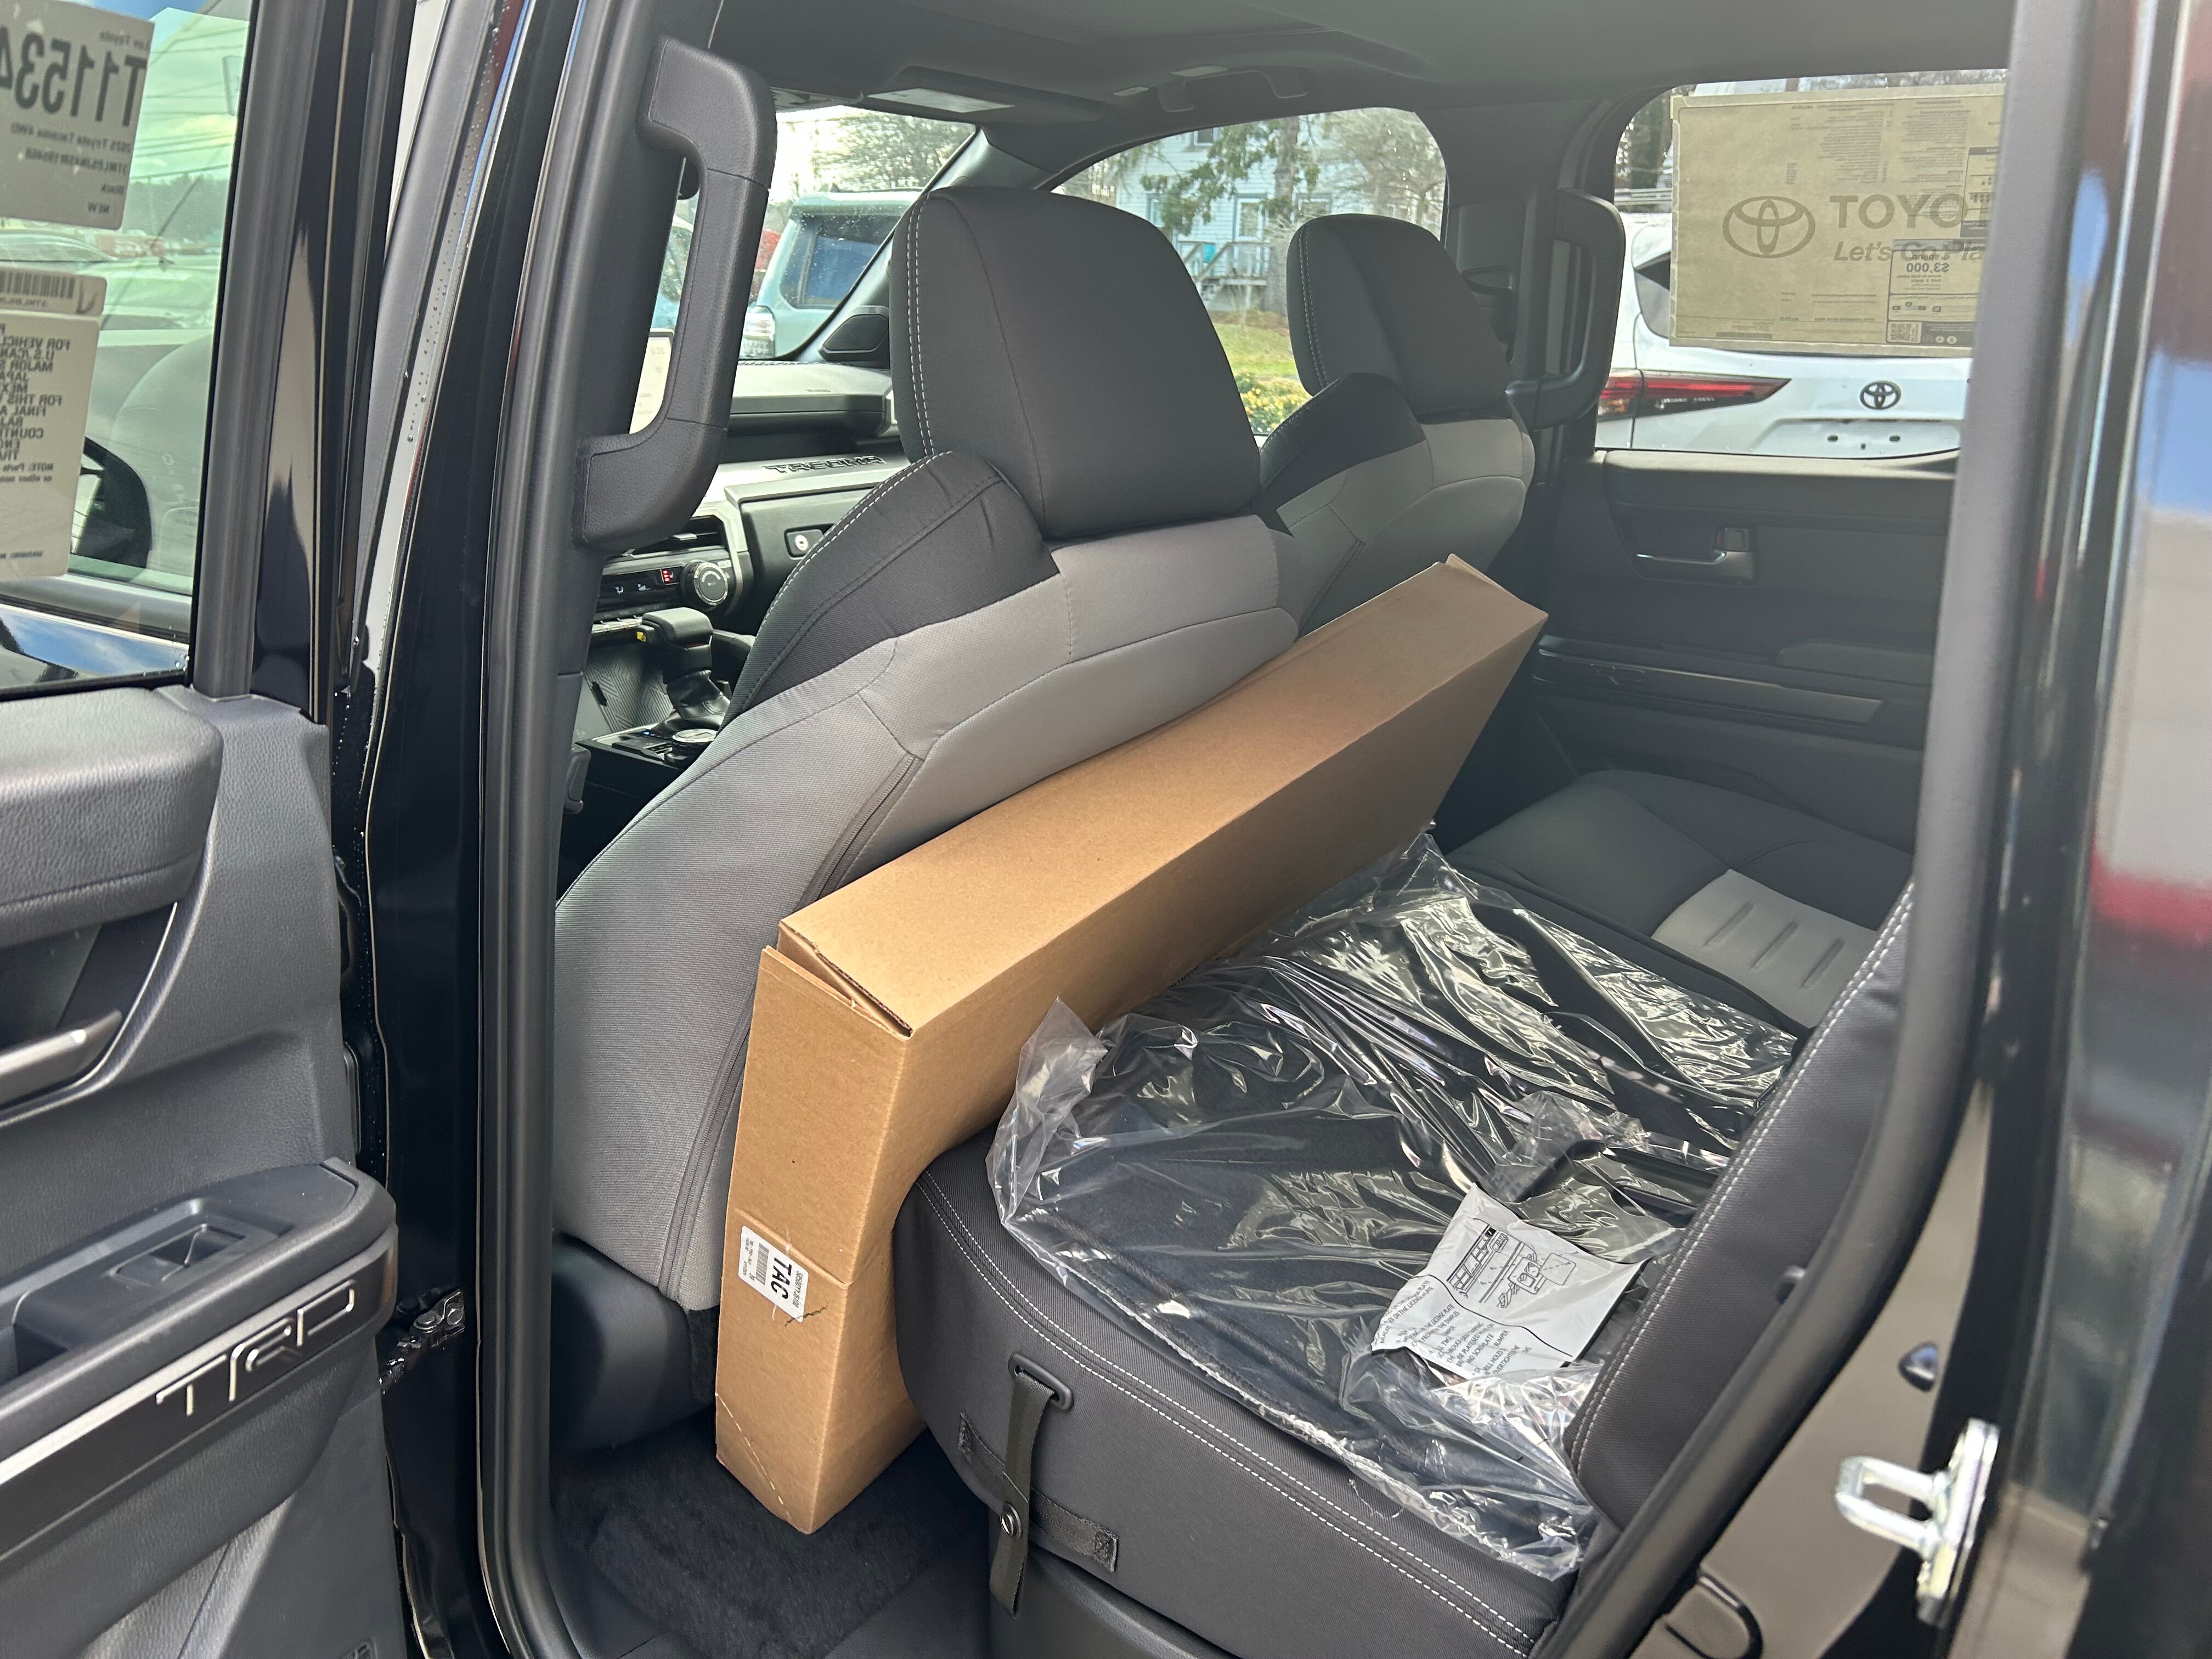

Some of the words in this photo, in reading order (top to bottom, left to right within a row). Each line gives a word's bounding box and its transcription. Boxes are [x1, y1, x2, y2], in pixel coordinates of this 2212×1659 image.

[1830, 193, 1991, 229] TOYOT
[1833, 240, 1893, 262] Let's
[762, 455, 888, 473] TACOMA
[770, 1256, 792, 1300] TAC
[1430, 1311, 1446, 1325] LICENSE
[1443, 1303, 1455, 1315] PLATE
[155, 1278, 357, 1418] TRD
[1489, 1349, 1504, 1364] HOLES
